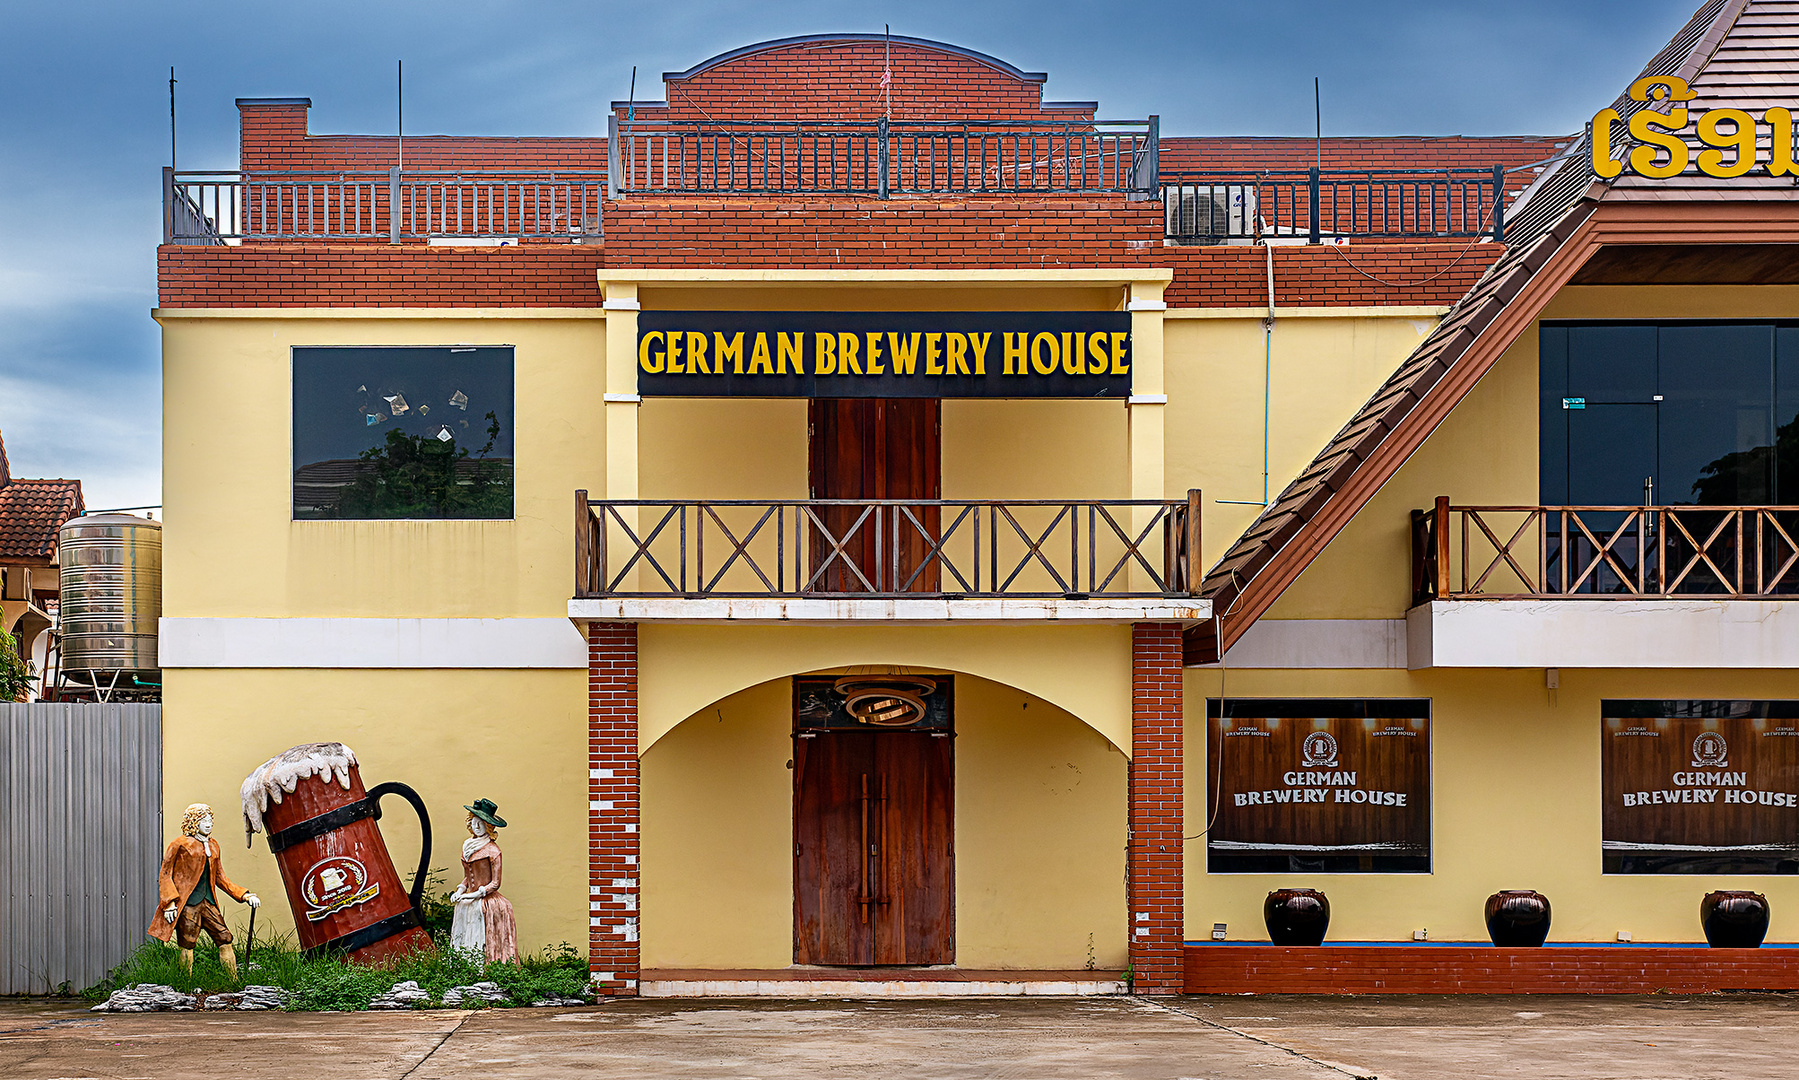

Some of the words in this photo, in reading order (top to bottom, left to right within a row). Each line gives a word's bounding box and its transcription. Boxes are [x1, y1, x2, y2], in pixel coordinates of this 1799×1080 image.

[638, 330, 804, 376] GERMAN
[814, 331, 991, 377] BREWERY
[1002, 331, 1131, 377] HOUSE
[1283, 771, 1357, 786] GERMAN
[1672, 771, 1747, 786] GERMAN
[1234, 788, 1329, 807] BREWERY
[1334, 789, 1407, 807] HOUSE
[1623, 789, 1719, 807] BREWERY
[1724, 789, 1798, 808] HOUSE
